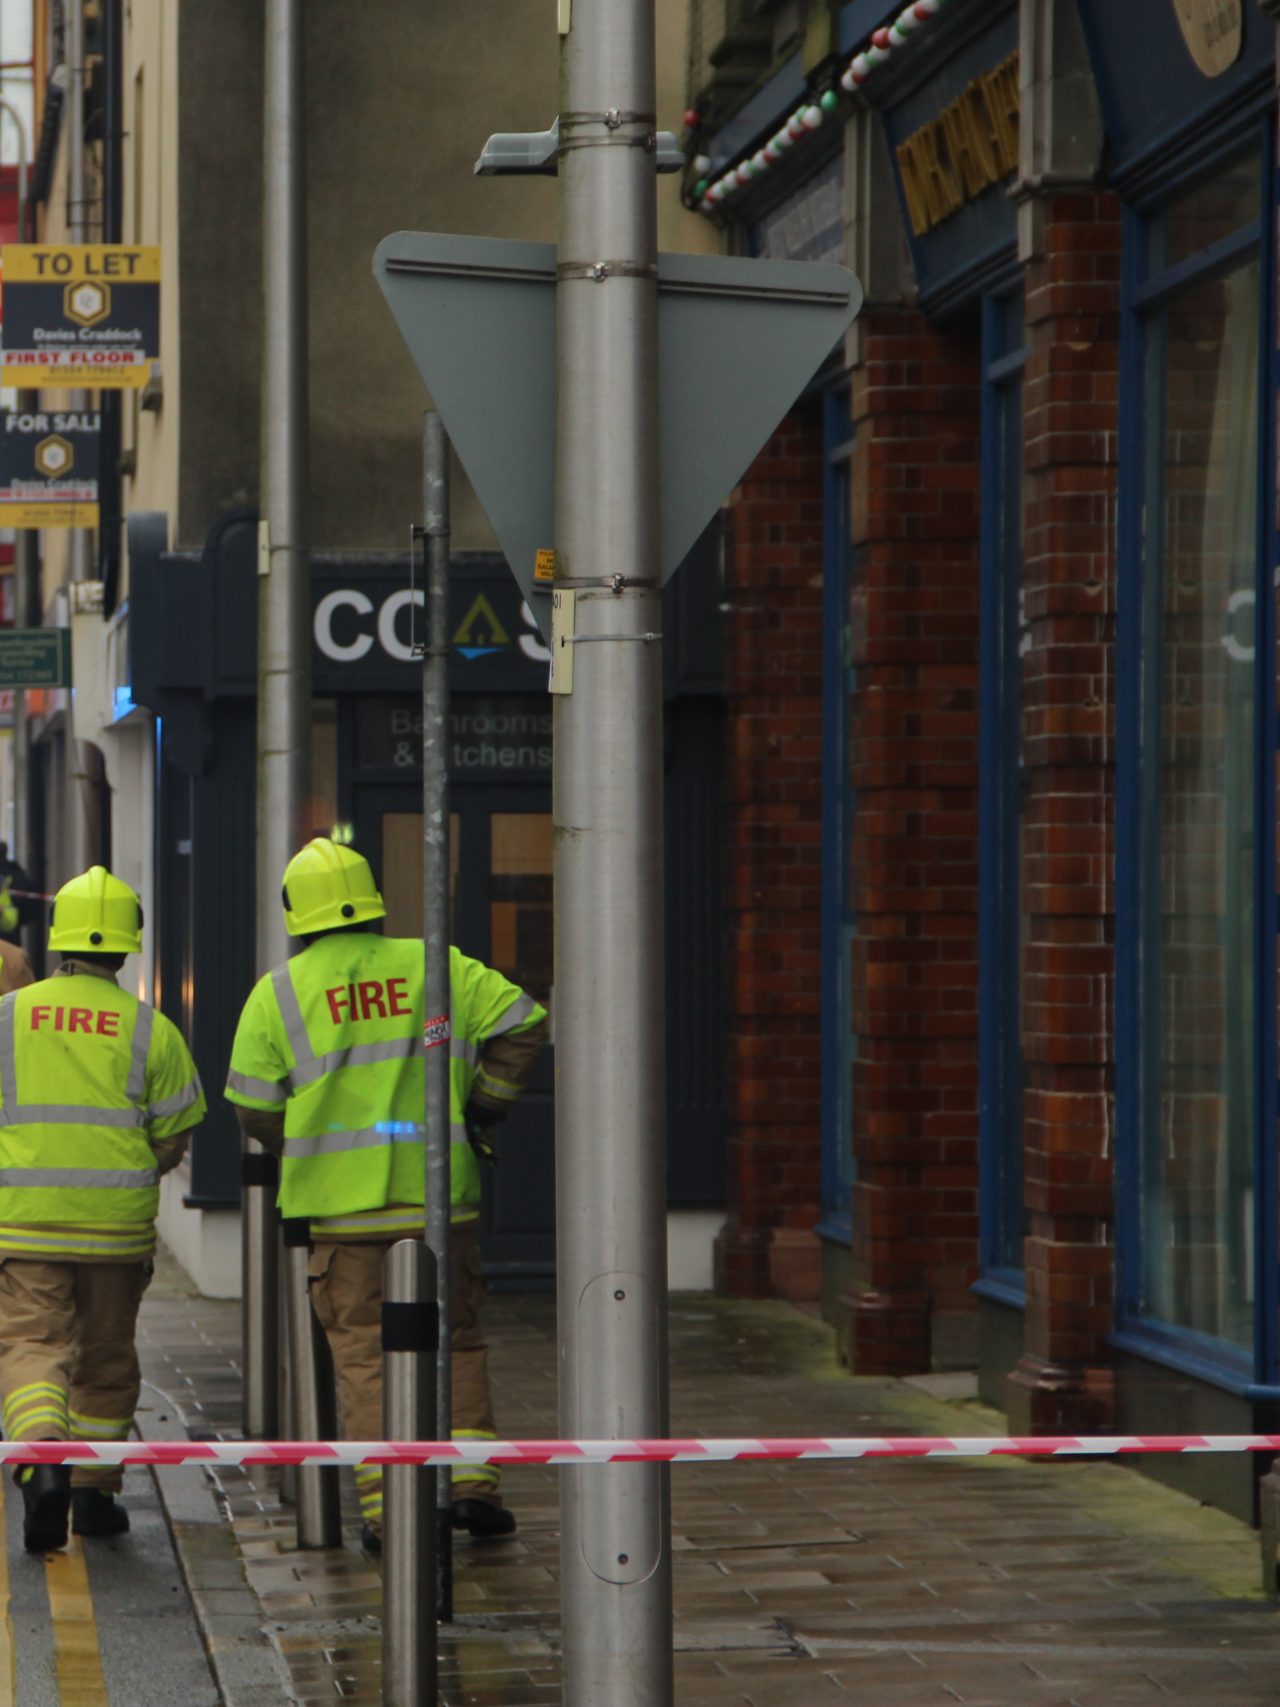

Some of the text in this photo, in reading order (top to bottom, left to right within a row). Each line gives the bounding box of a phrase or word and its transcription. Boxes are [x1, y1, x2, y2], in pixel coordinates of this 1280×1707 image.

[34, 253, 140, 275] TO LET
[33, 327, 142, 341] Davies Craddock
[5, 351, 135, 364] FIRST FLOOR
[5, 414, 49, 433] FOR
[392, 709, 553, 735] Barooms
[393, 742, 417, 767] &
[325, 978, 413, 1025] FIRE
[31, 1005, 120, 1038] FIRE
